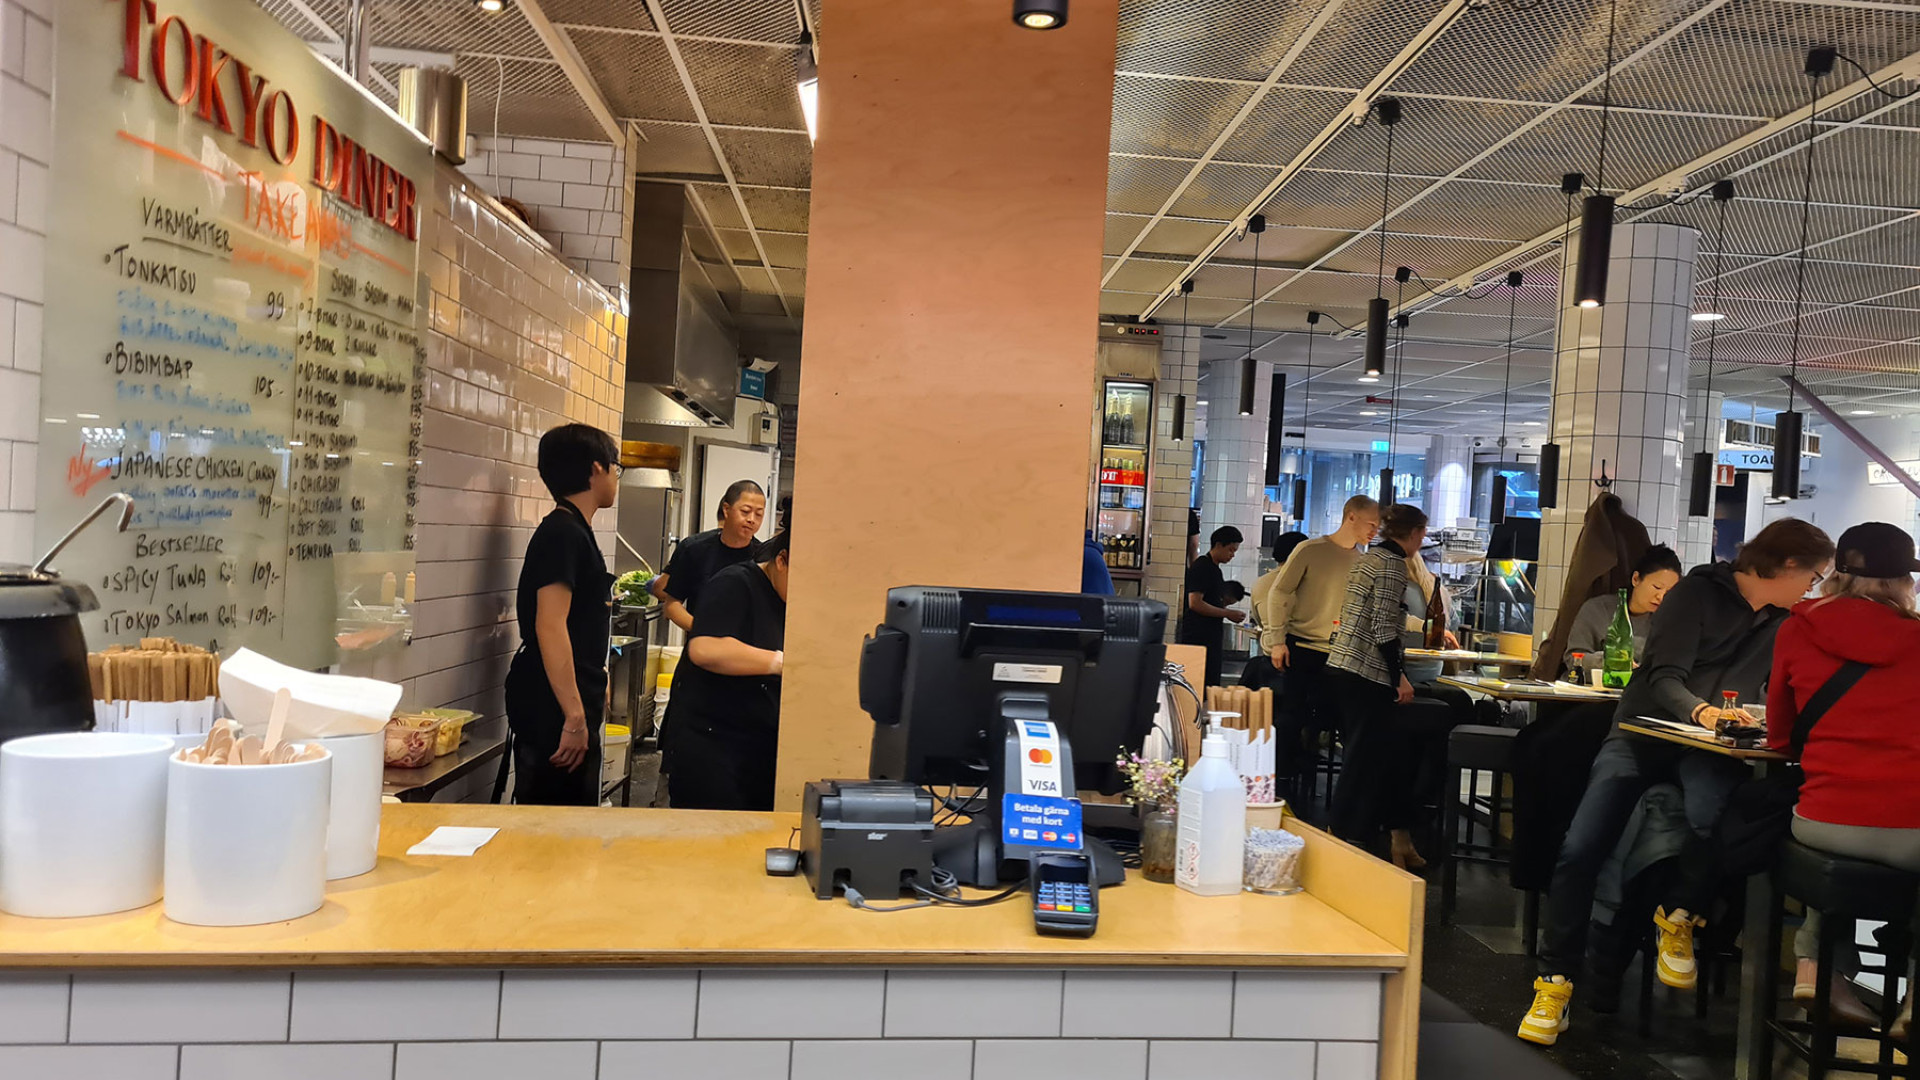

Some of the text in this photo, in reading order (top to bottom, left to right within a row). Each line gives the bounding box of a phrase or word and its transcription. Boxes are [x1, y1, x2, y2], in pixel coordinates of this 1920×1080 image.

[109, 0, 299, 166] TOKYO
[309, 114, 417, 242] DINER
[238, 170, 303, 240] TAKE
[114, 244, 196, 295] TONKATSU
[115, 340, 193, 380] BIBIMBAP
[111, 444, 193, 480] JAPANESE
[195, 456, 244, 481] CHICKEN
[295, 542, 334, 562] TEMPURA
[113, 565, 159, 605] SPICY
[110, 609, 160, 638] TOKYO
[1028, 779, 1057, 792] VISA
[1014, 802, 1070, 816] Betala gärna
[1022, 815, 1063, 827] med kort
